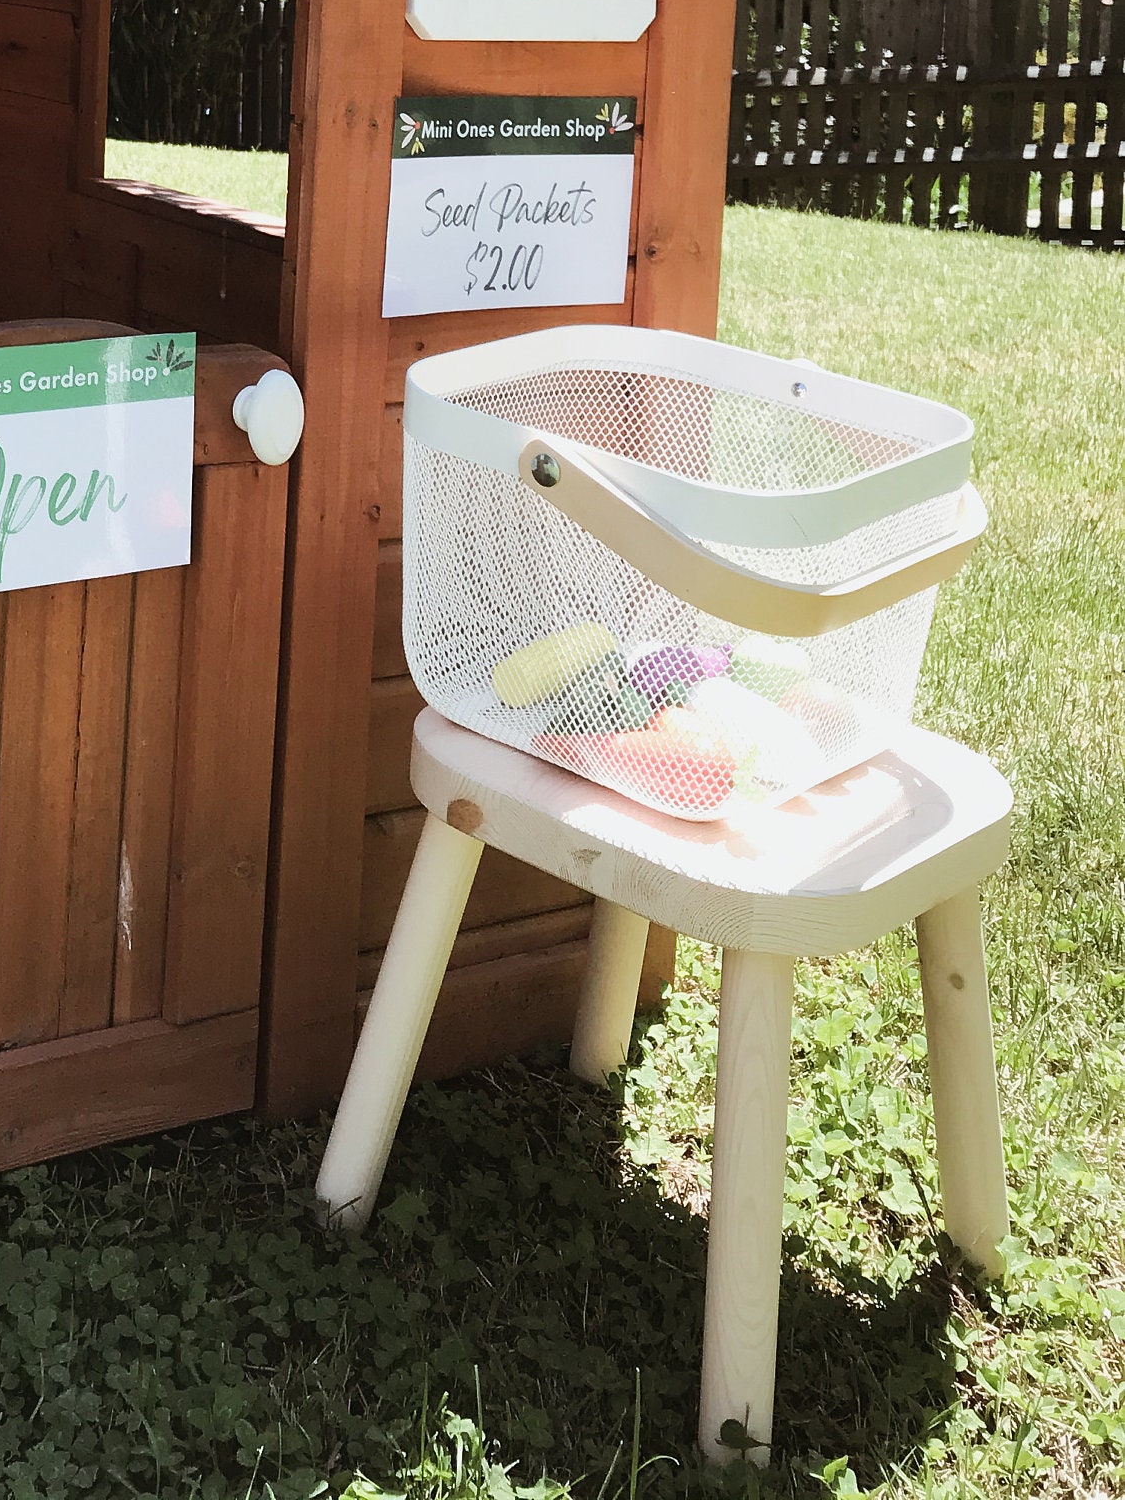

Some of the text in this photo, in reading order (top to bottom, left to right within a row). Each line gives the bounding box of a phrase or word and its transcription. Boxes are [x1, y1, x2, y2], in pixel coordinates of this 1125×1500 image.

[421, 118, 606, 142] Mini Ones Garden Shop
[422, 181, 596, 237] Seed Packets
[463, 241, 544, 296] $2.00
[19, 366, 99, 393] Garden
[106, 364, 158, 386] Shop
